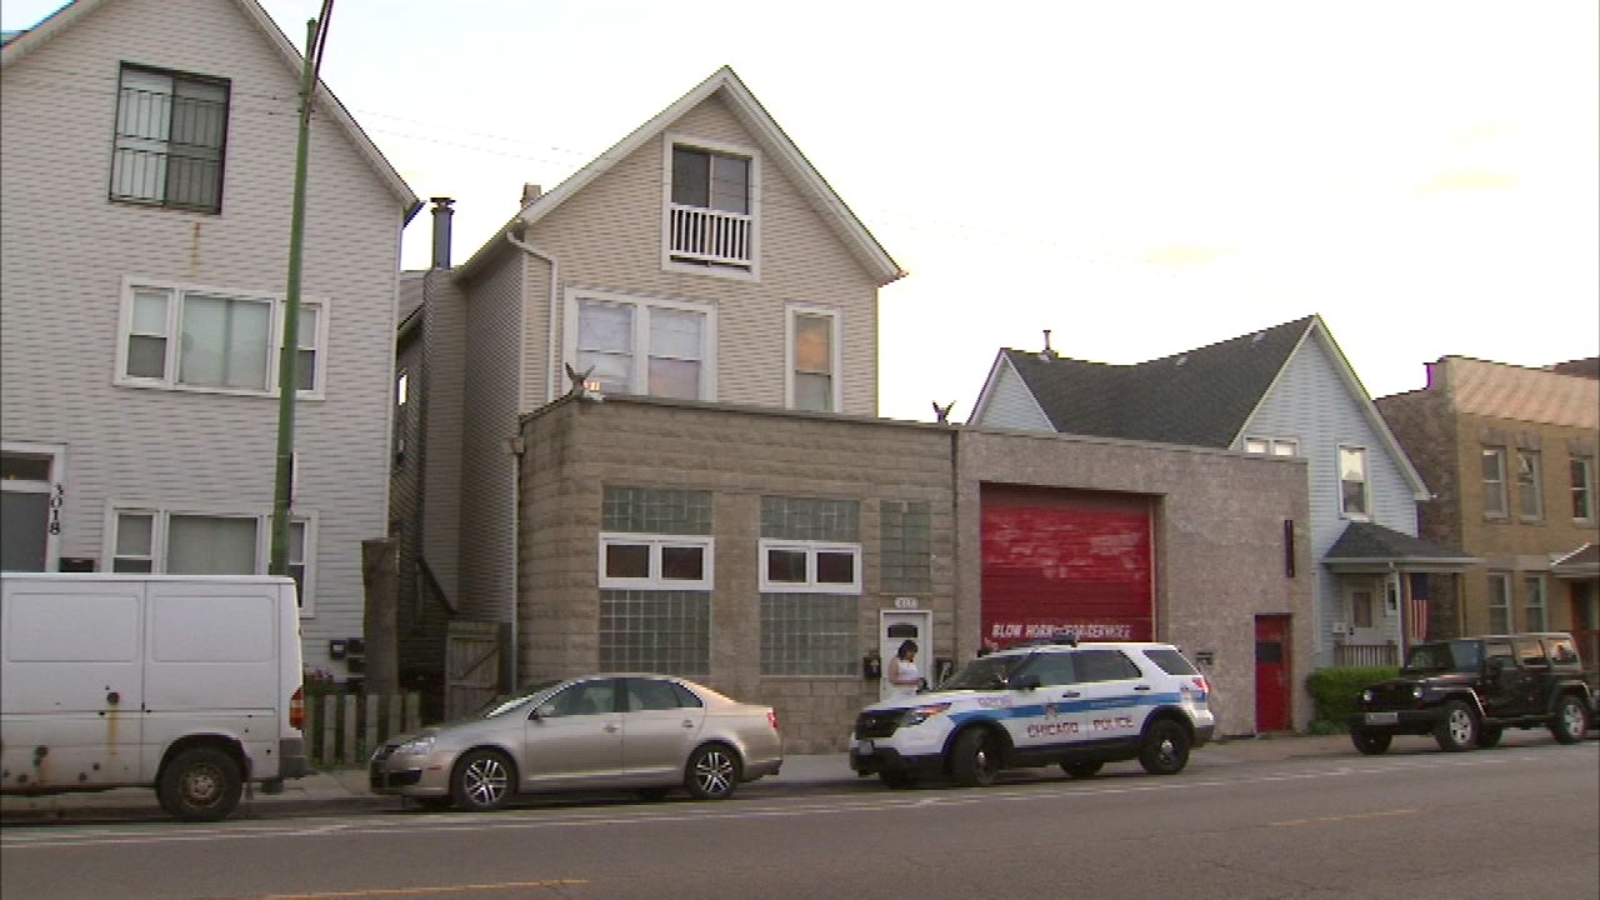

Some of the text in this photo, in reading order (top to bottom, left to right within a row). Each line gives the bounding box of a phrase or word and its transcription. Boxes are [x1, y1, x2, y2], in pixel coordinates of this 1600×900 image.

[50, 482, 64, 536] 3018
[992, 624, 1022, 638] BLOW
[1025, 624, 1055, 639] HORN
[1027, 717, 1134, 738] CHICAGO POLICE
